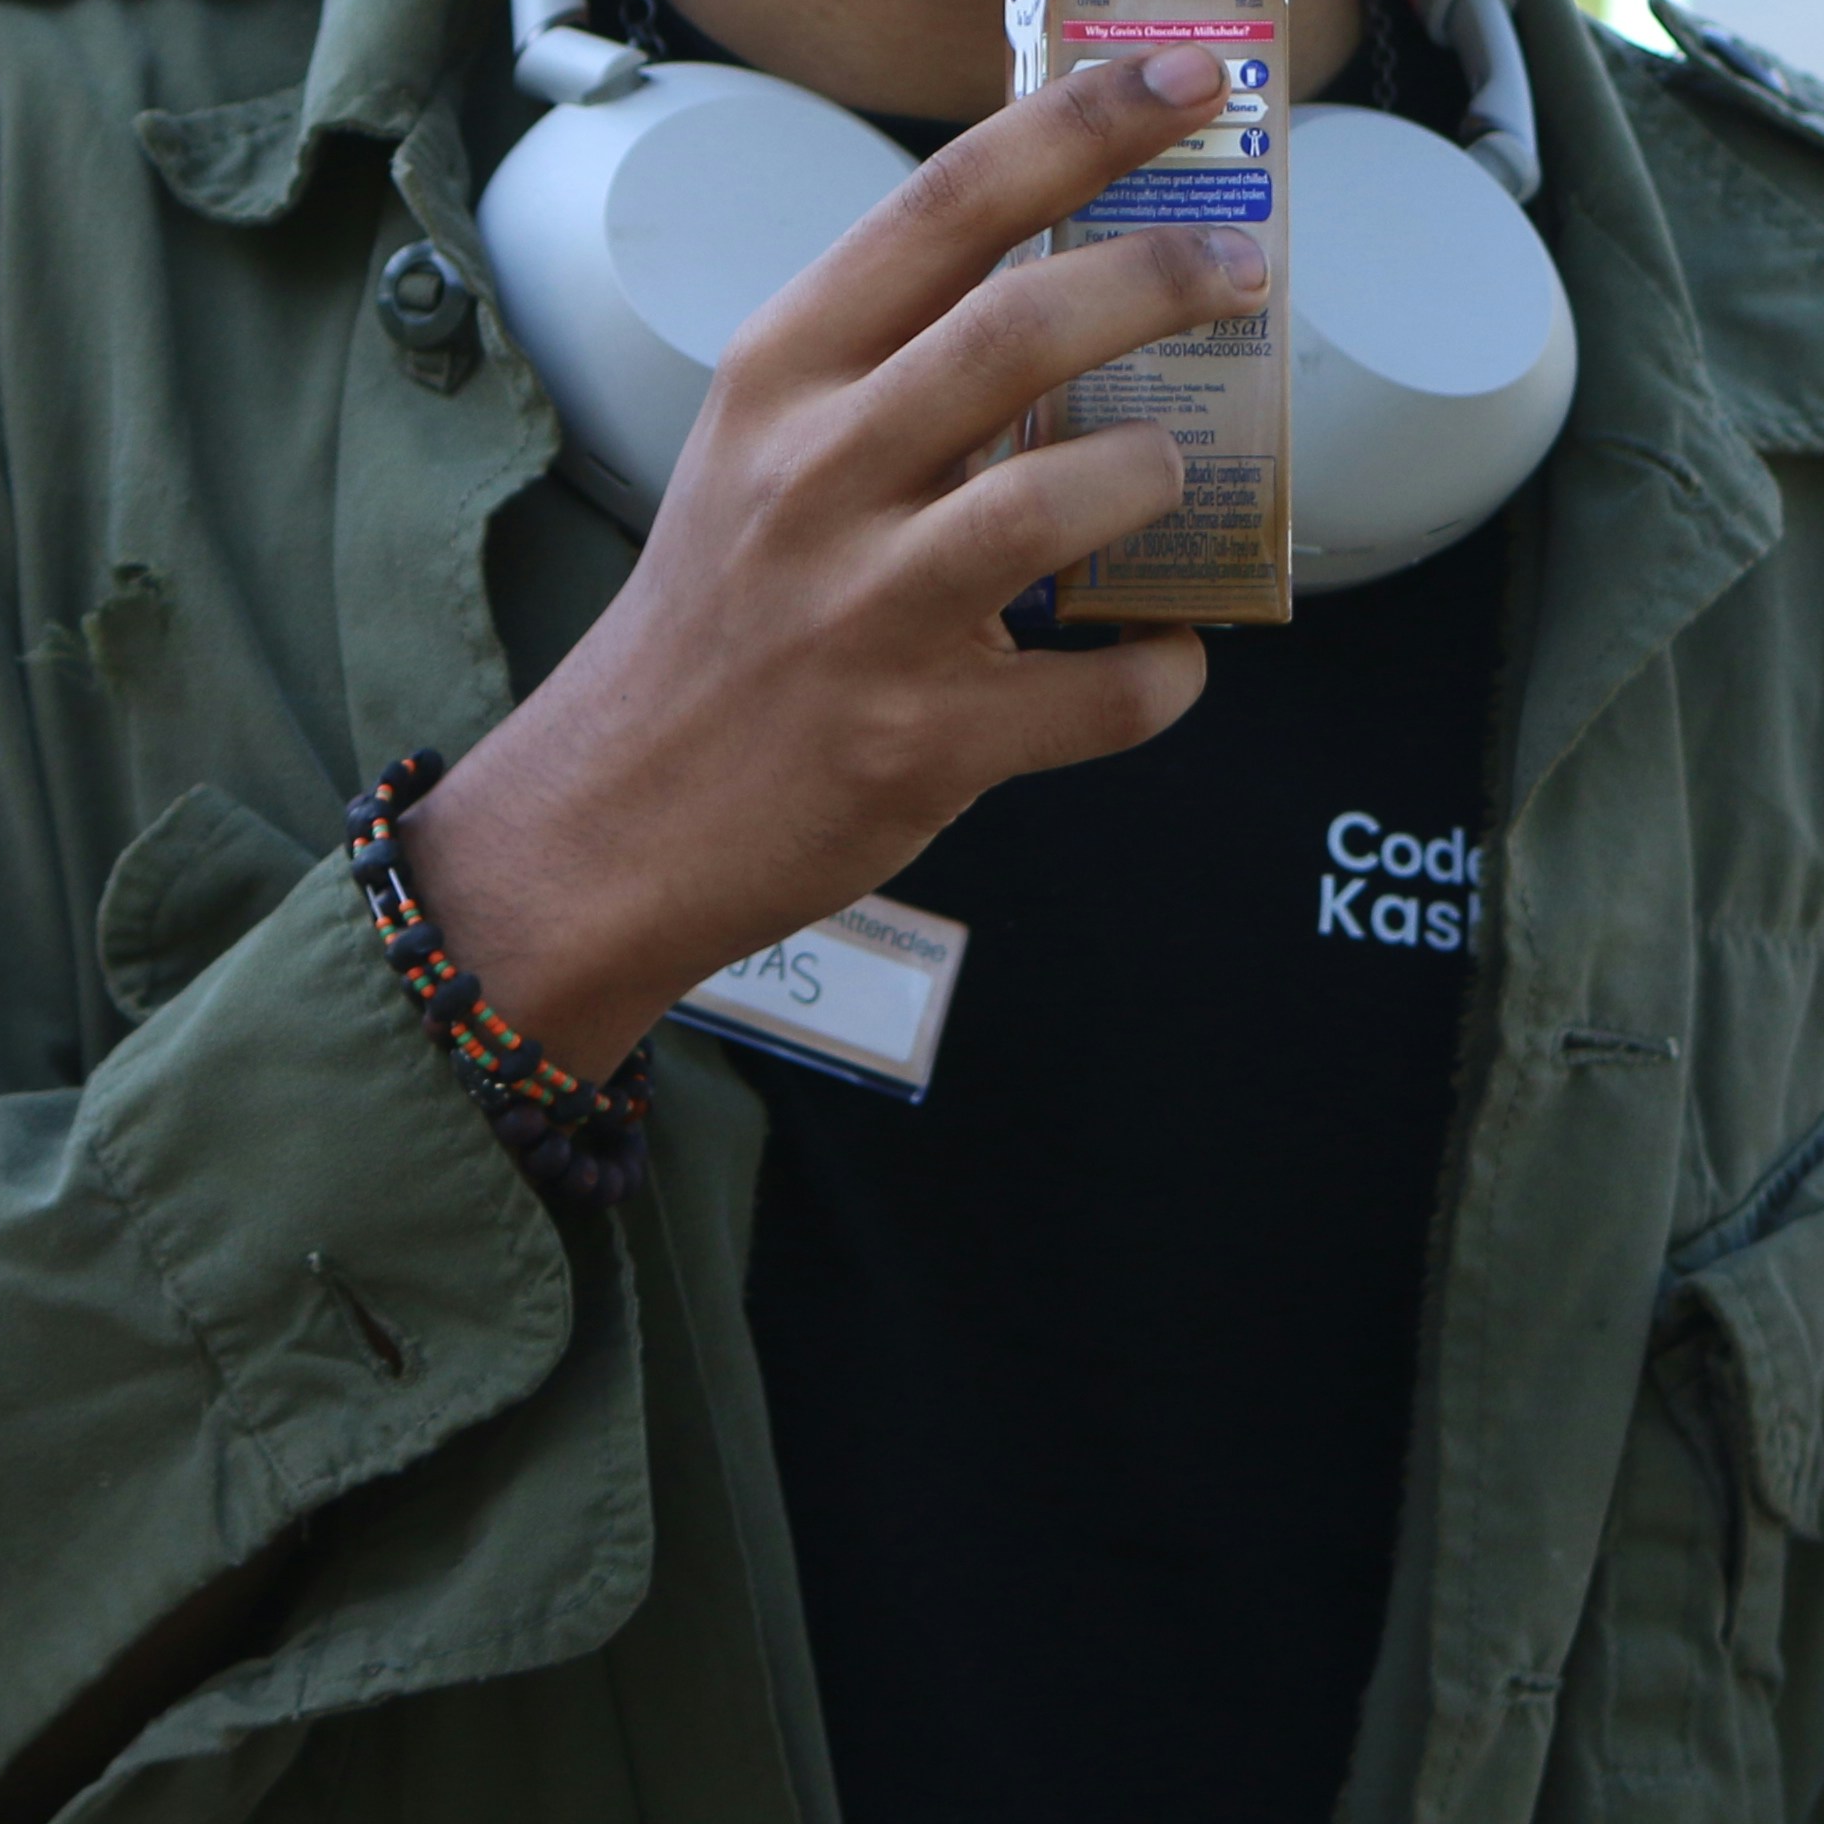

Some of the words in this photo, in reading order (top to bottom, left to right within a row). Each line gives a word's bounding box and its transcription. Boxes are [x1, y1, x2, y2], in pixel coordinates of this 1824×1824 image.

[1085, 25, 1108, 39] Why
[1110, 25, 1143, 37] Cavin's
[1144, 25, 1191, 37] Chocolate
[1193, 25, 1250, 37] Milkshake?
[1226, 102, 1258, 112] Bones
[1172, 175, 1192, 188] great
[1194, 173, 1214, 185] when
[1215, 173, 1241, 185] served
[1085, 229, 1104, 242] For
[1158, 342, 1273, 357] 10014042001362
